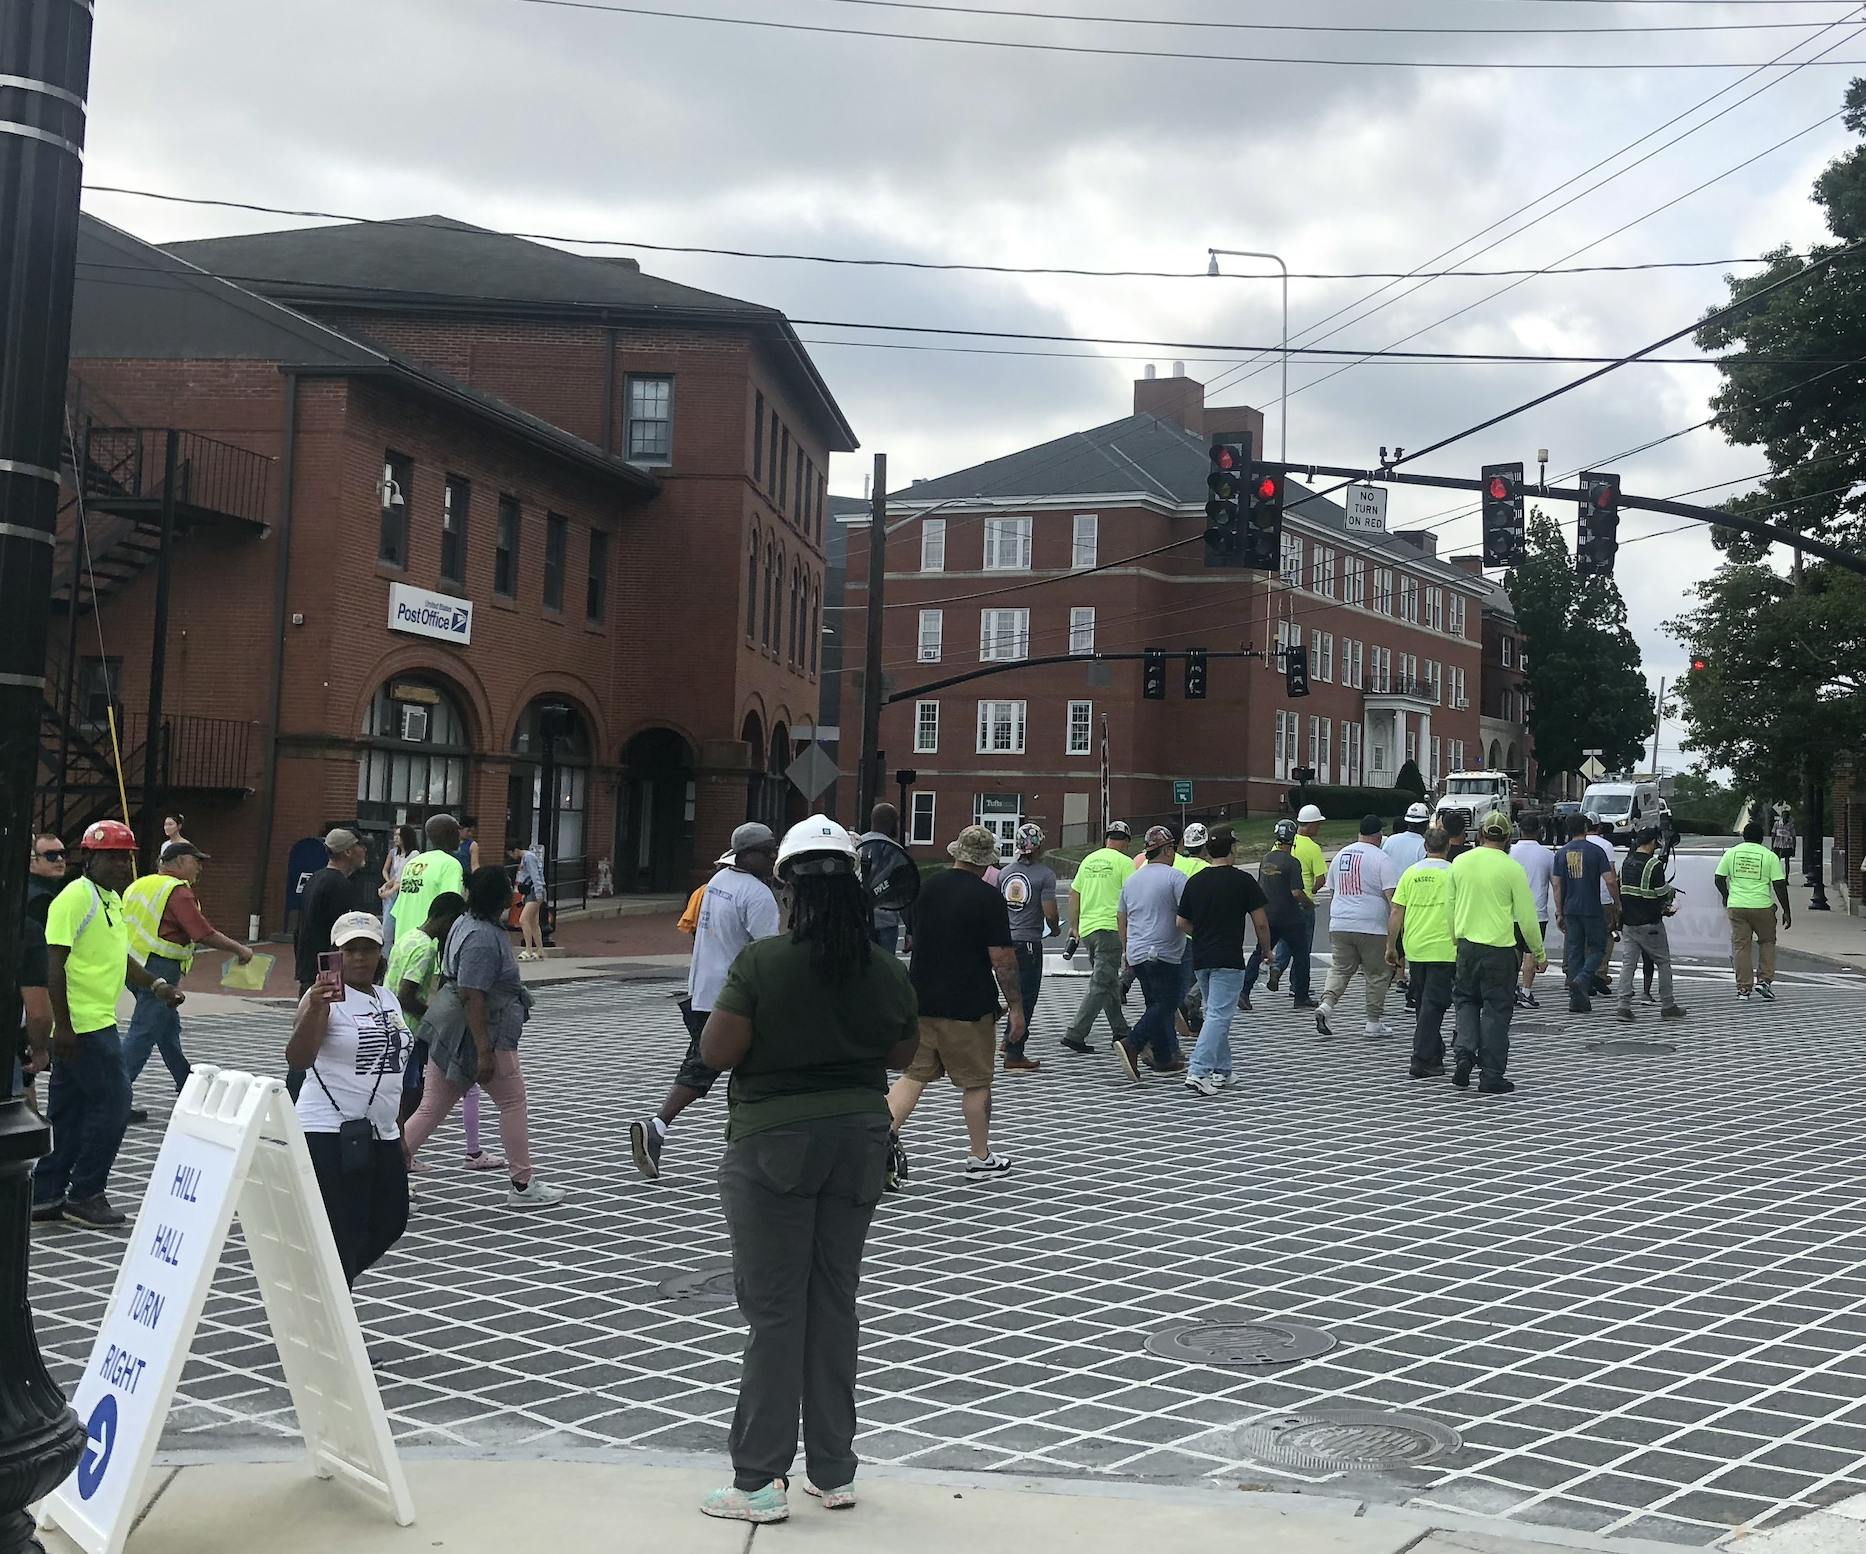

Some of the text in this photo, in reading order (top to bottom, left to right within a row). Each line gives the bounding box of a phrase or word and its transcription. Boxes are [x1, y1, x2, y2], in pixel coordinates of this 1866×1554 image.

[1355, 504, 1377, 514] TURN
[1360, 491, 1374, 501] NO
[1348, 516, 1382, 528] ON RED
[398, 603, 450, 630] Post Office
[986, 799, 1003, 807] Tufts
[170, 1163, 203, 1205] HILL
[149, 1223, 186, 1267] HALL
[127, 1283, 167, 1331] TURN
[99, 1343, 148, 1396] RIGHT
